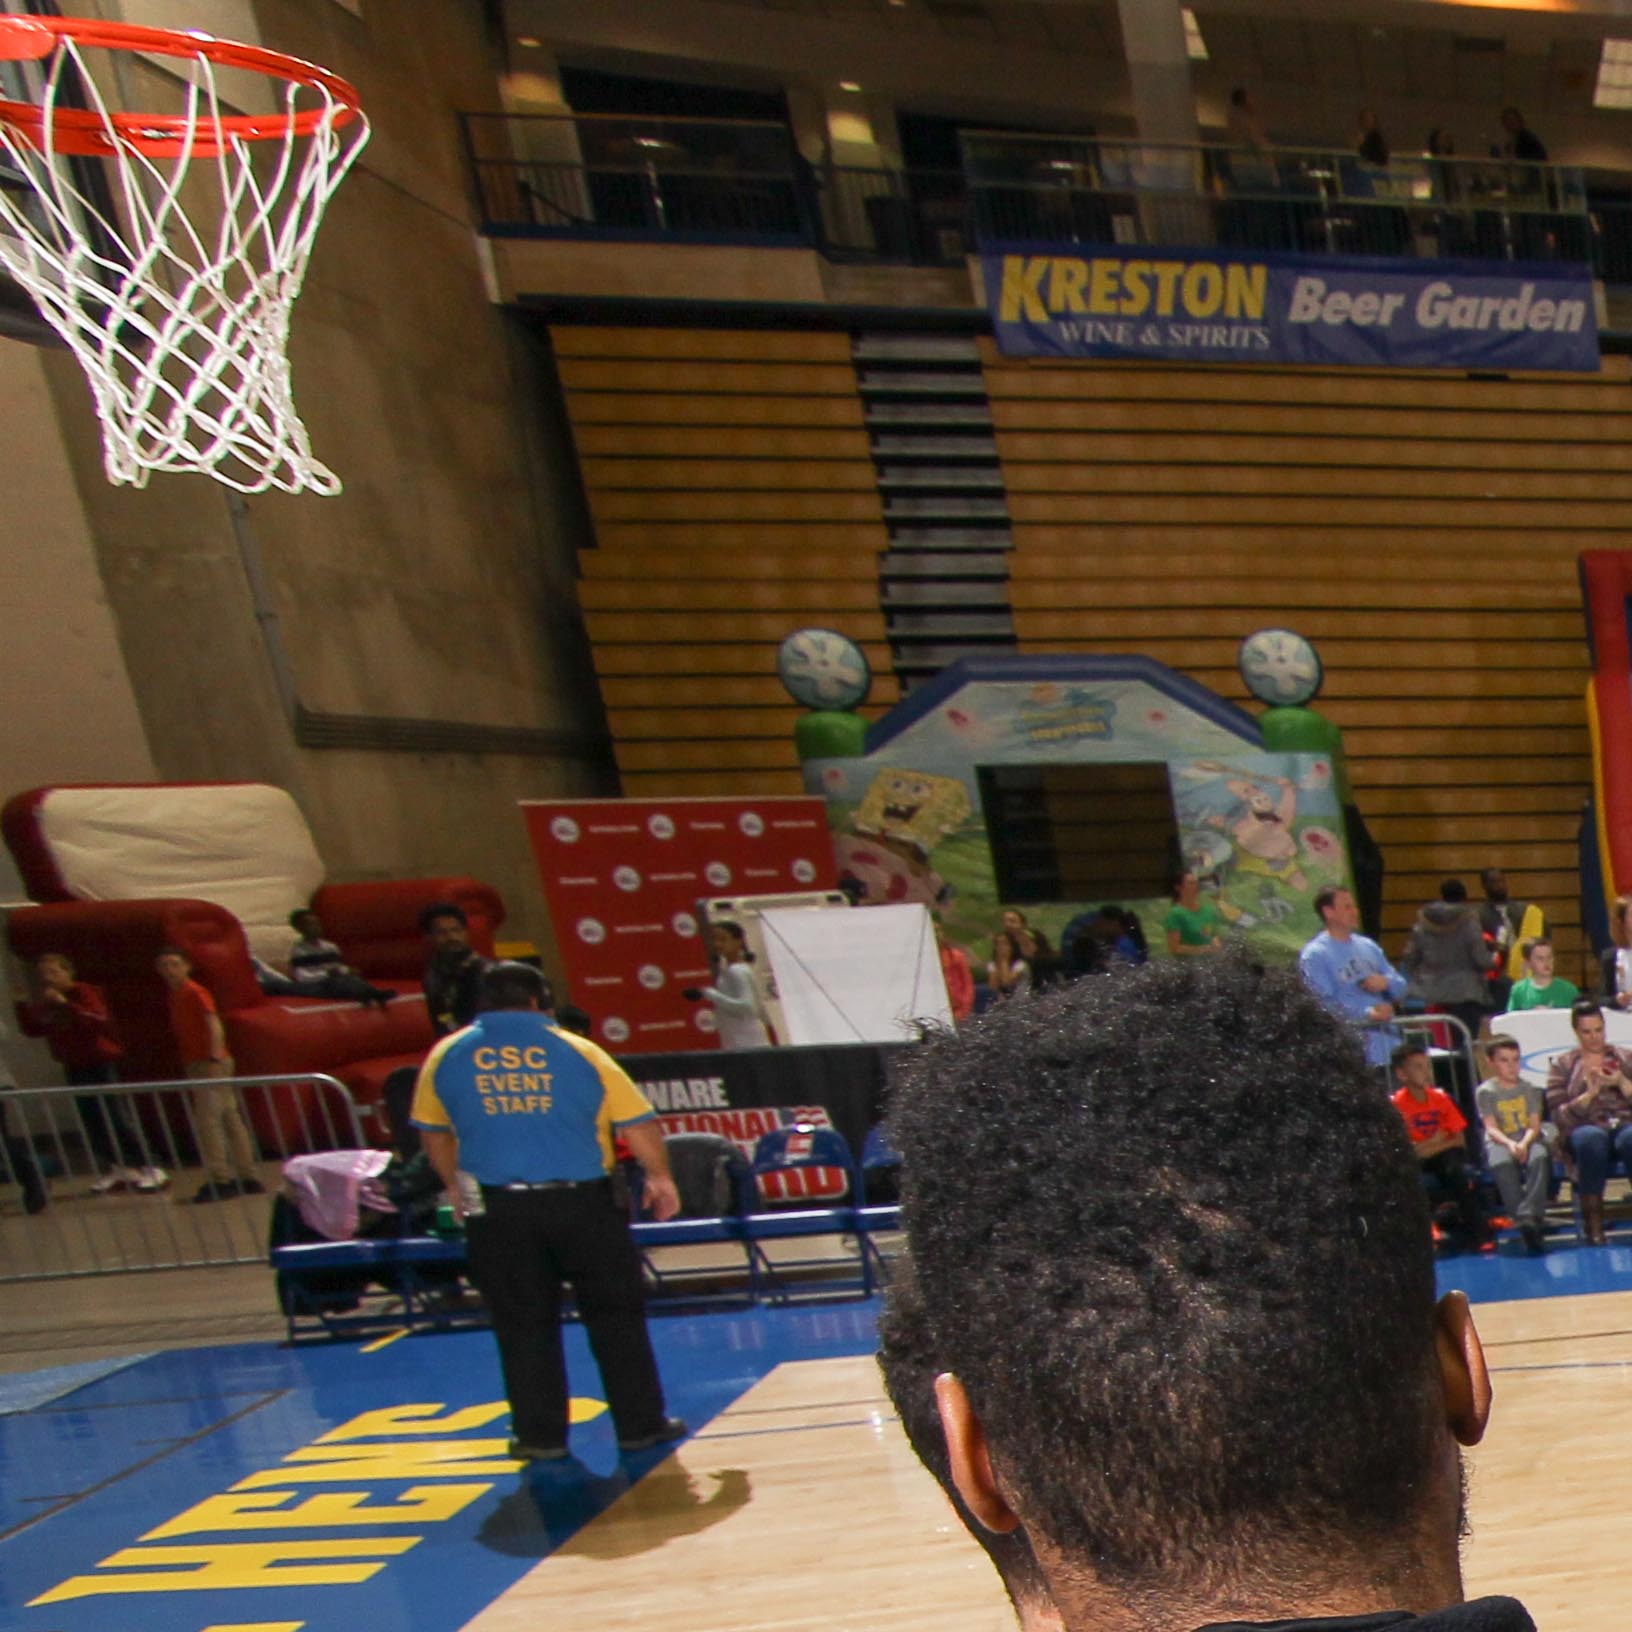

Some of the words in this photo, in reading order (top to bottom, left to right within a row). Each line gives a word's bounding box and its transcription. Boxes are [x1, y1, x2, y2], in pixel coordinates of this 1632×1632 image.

[1000, 255, 1267, 323] KRESTON
[1289, 277, 1404, 327] Beer
[1415, 281, 1585, 332] Garden
[1060, 321, 1131, 346] WINE
[1140, 324, 1161, 345] &
[1167, 322, 1271, 350] SPIRITS
[473, 1046, 547, 1070] CSC
[475, 1074, 553, 1095] EVENT
[640, 1077, 730, 1111] WARE
[483, 1097, 553, 1116] STAFF
[660, 1107, 783, 1141] TIONAL
[25, 1396, 609, 1608] HENS
